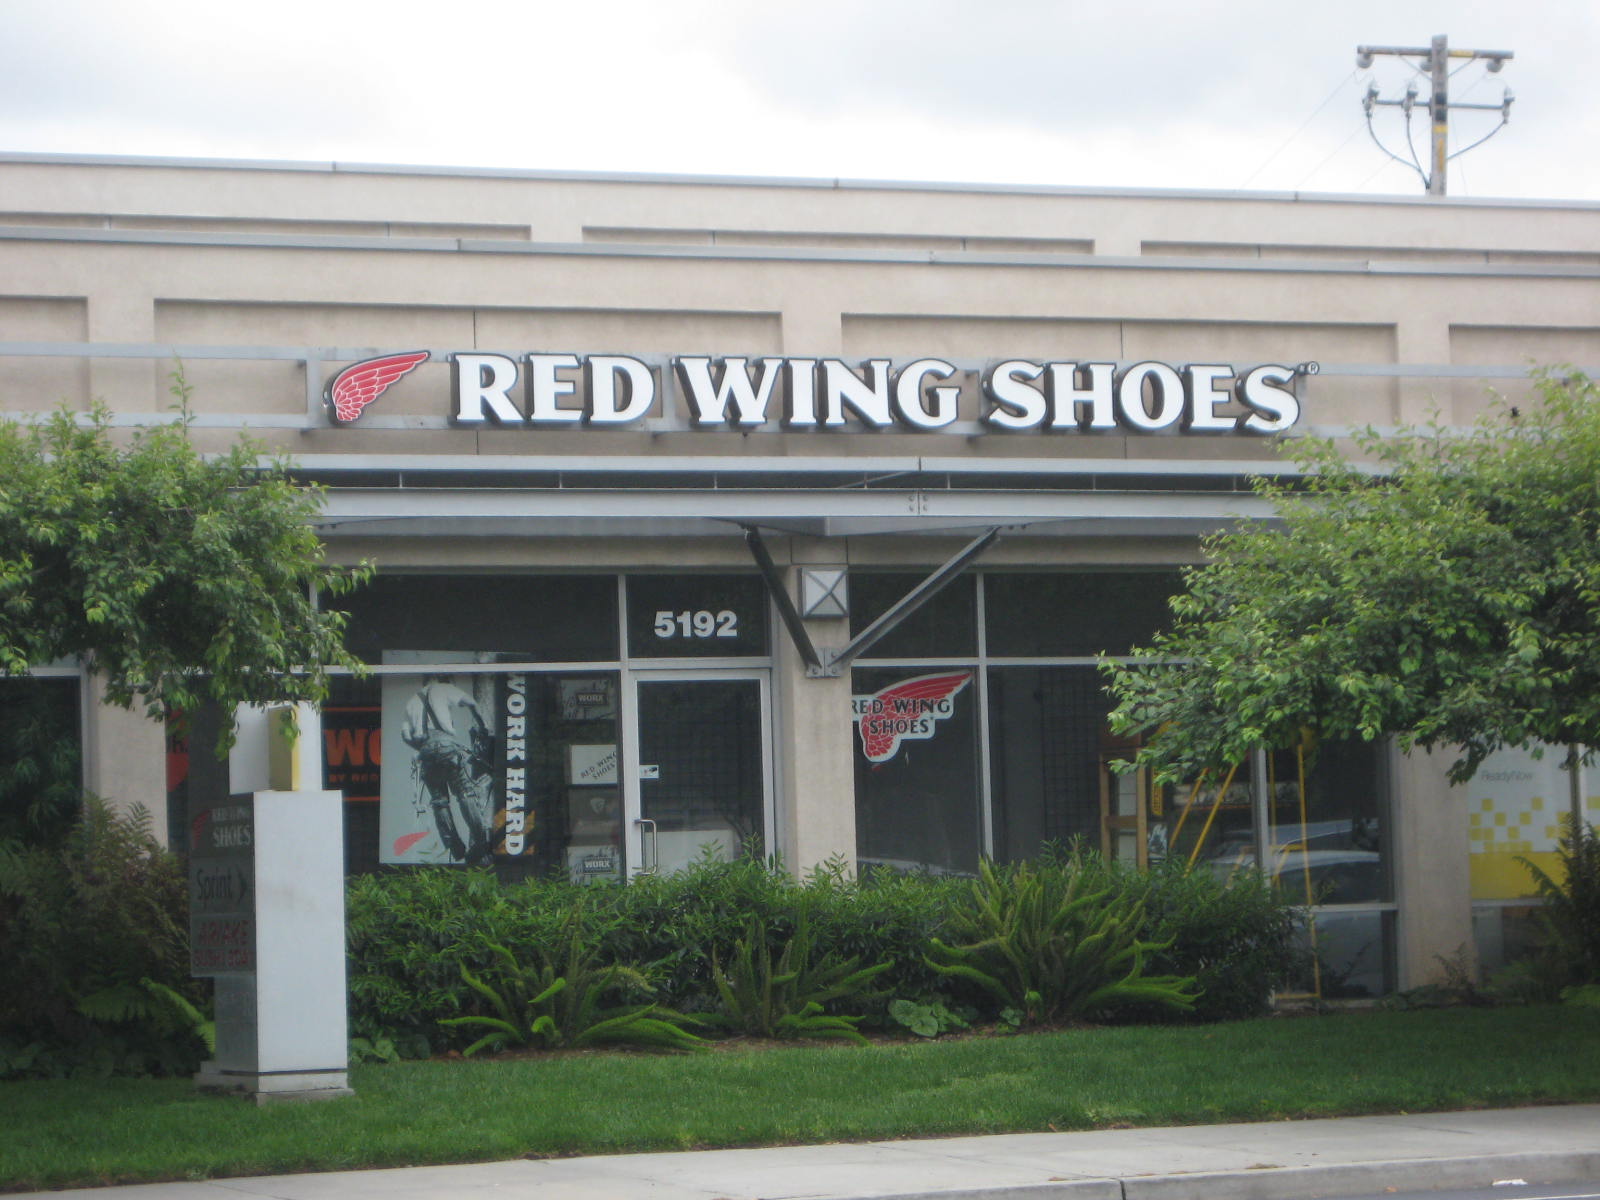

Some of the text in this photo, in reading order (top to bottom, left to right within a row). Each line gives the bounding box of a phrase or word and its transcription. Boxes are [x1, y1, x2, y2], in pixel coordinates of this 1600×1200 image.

[452, 352, 1301, 432] RED WING SHOES
[654, 609, 738, 638] 5192
[851, 699, 951, 714] RED WING
[869, 719, 930, 735] SHOES
[505, 671, 526, 856] WORK HARD
[212, 824, 251, 848] SHOES
[197, 866, 232, 910] Sprint
